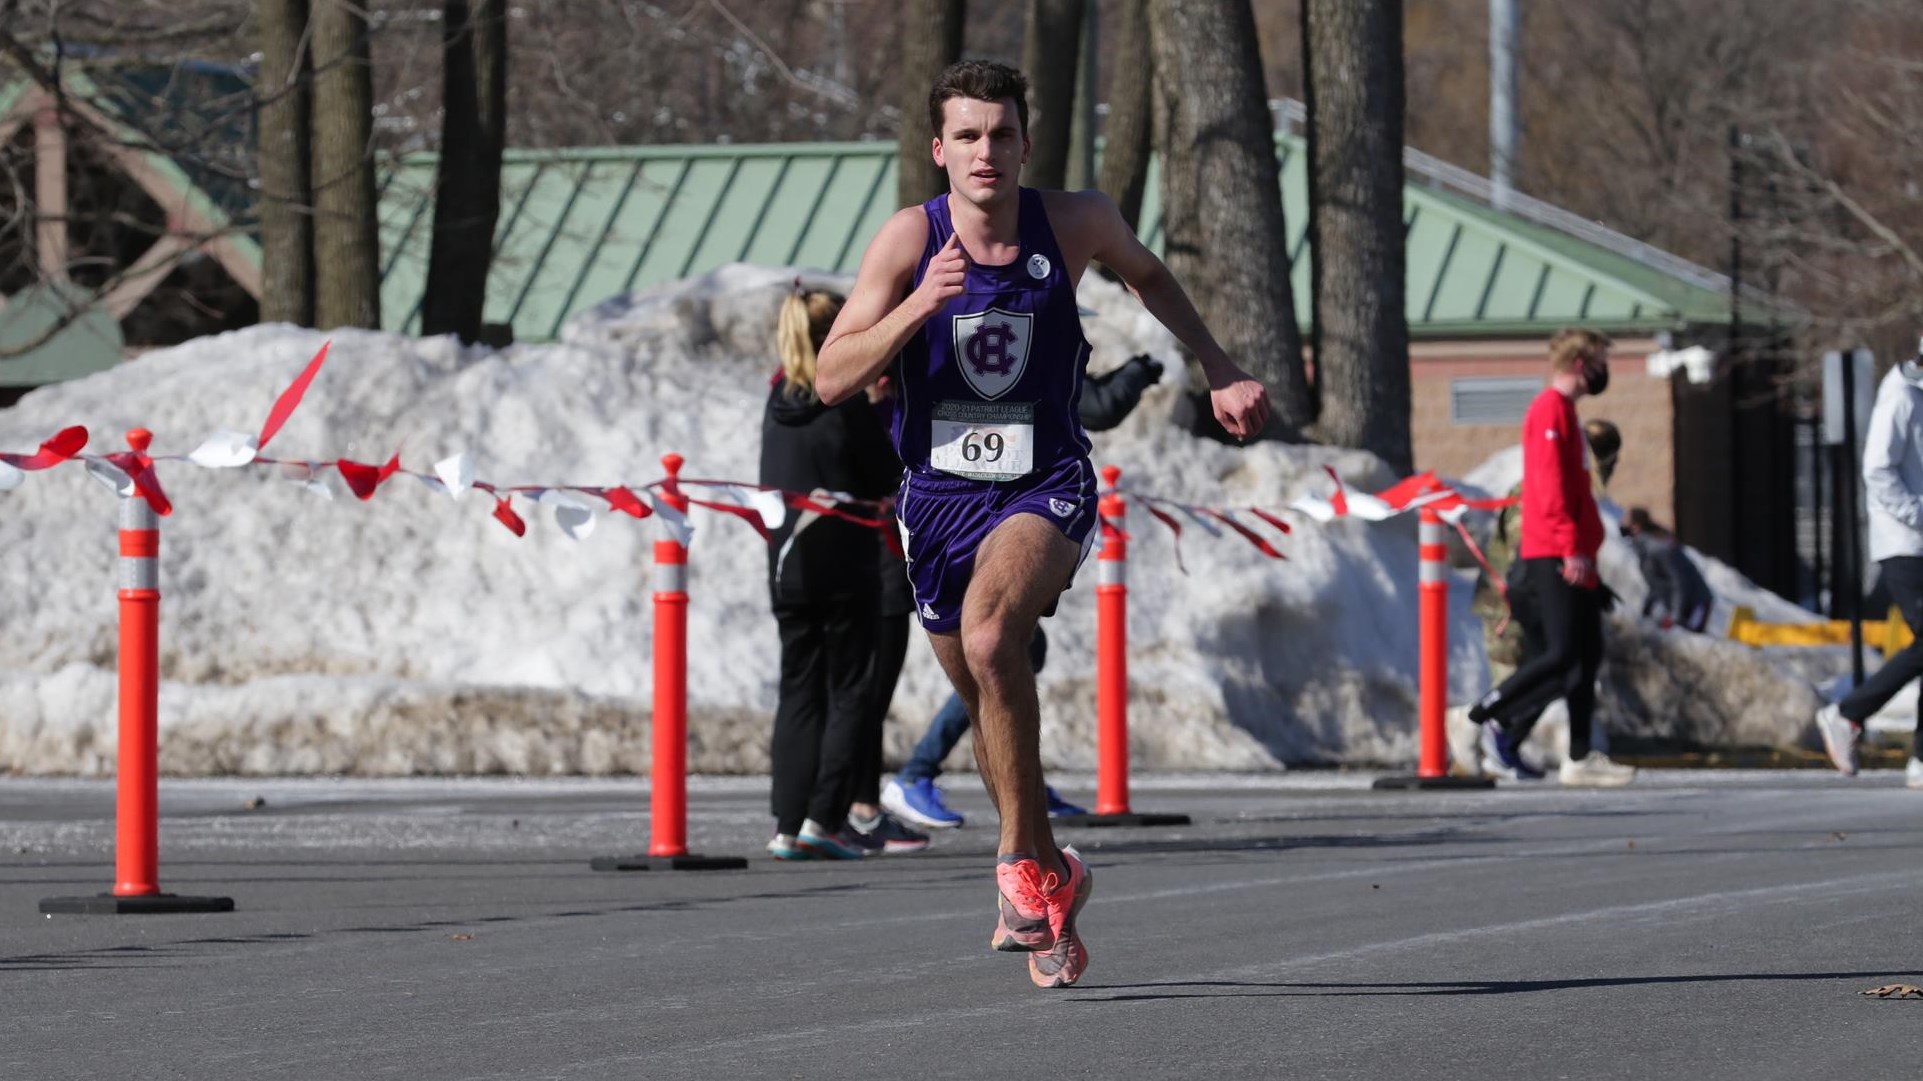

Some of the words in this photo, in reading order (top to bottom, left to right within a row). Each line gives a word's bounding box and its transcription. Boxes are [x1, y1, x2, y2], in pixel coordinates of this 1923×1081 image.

[971, 404, 999, 412] PATRIOT
[1001, 405, 1028, 413] LEAGUE
[962, 433, 1004, 462] 69
